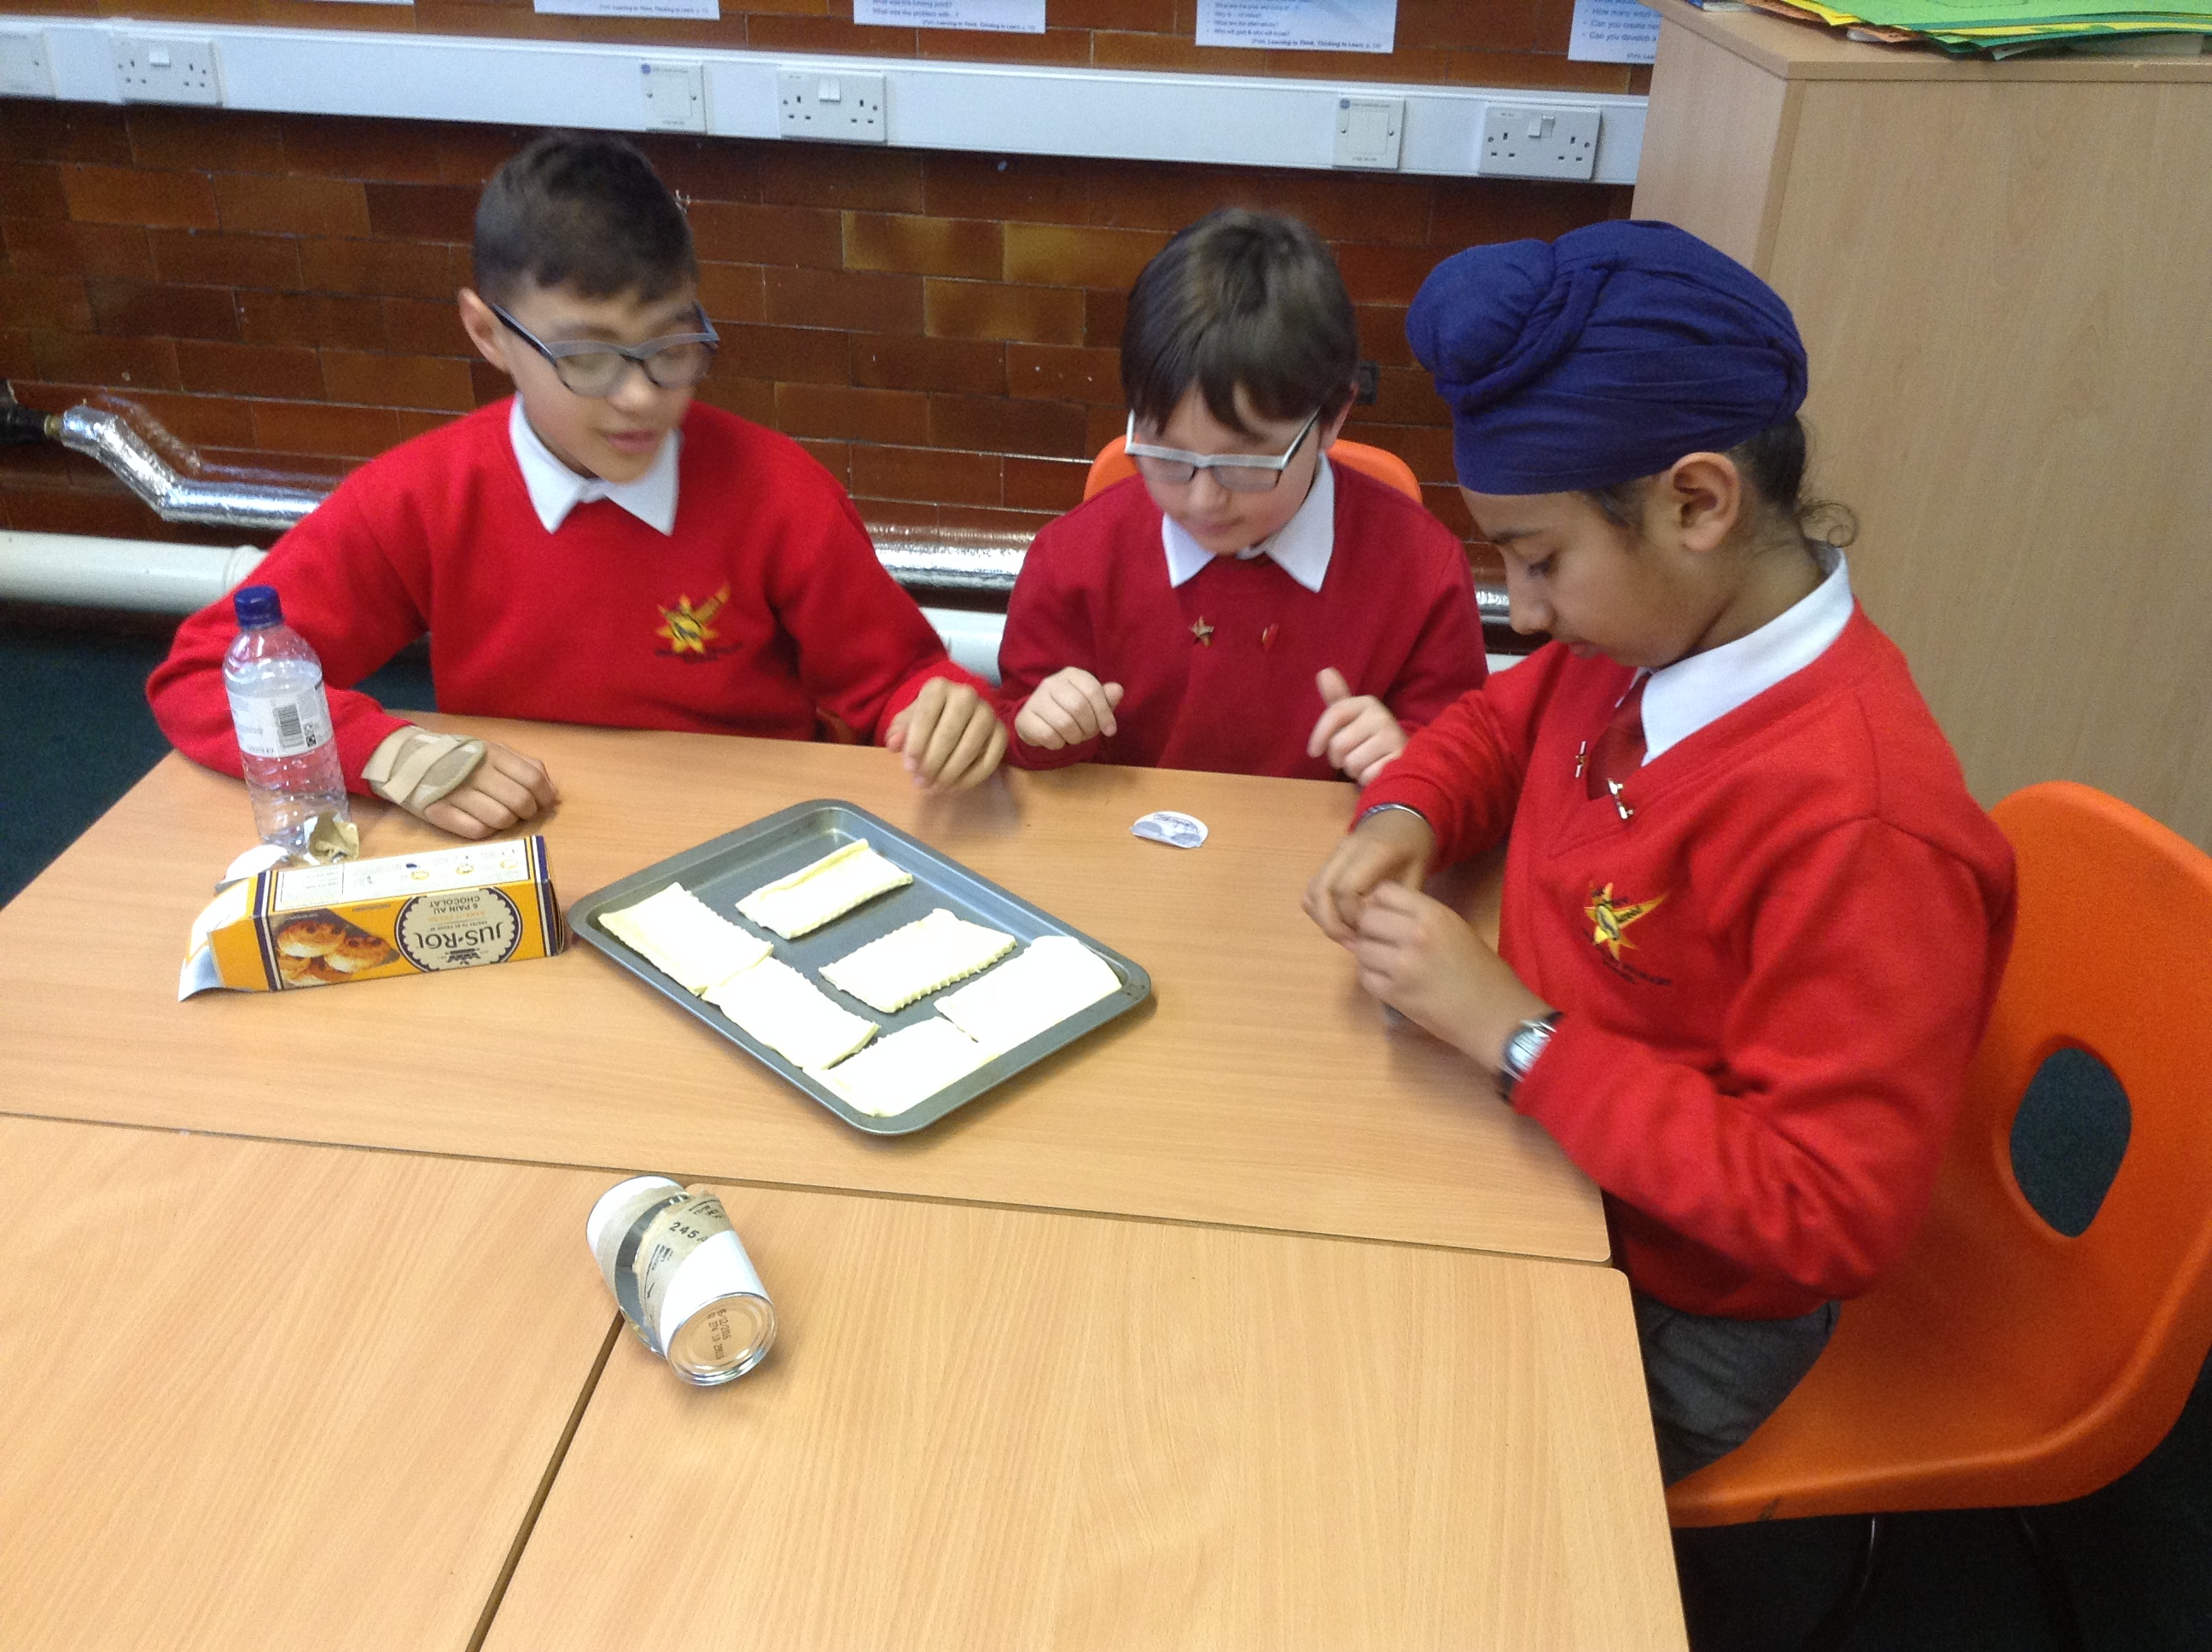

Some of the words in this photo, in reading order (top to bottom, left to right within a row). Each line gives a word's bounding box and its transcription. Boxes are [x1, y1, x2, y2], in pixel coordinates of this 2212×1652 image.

[1591, 19, 1606, 27] Can
[1589, 31, 1604, 39] Can
[429, 896, 480, 908] CHOCOLAT
